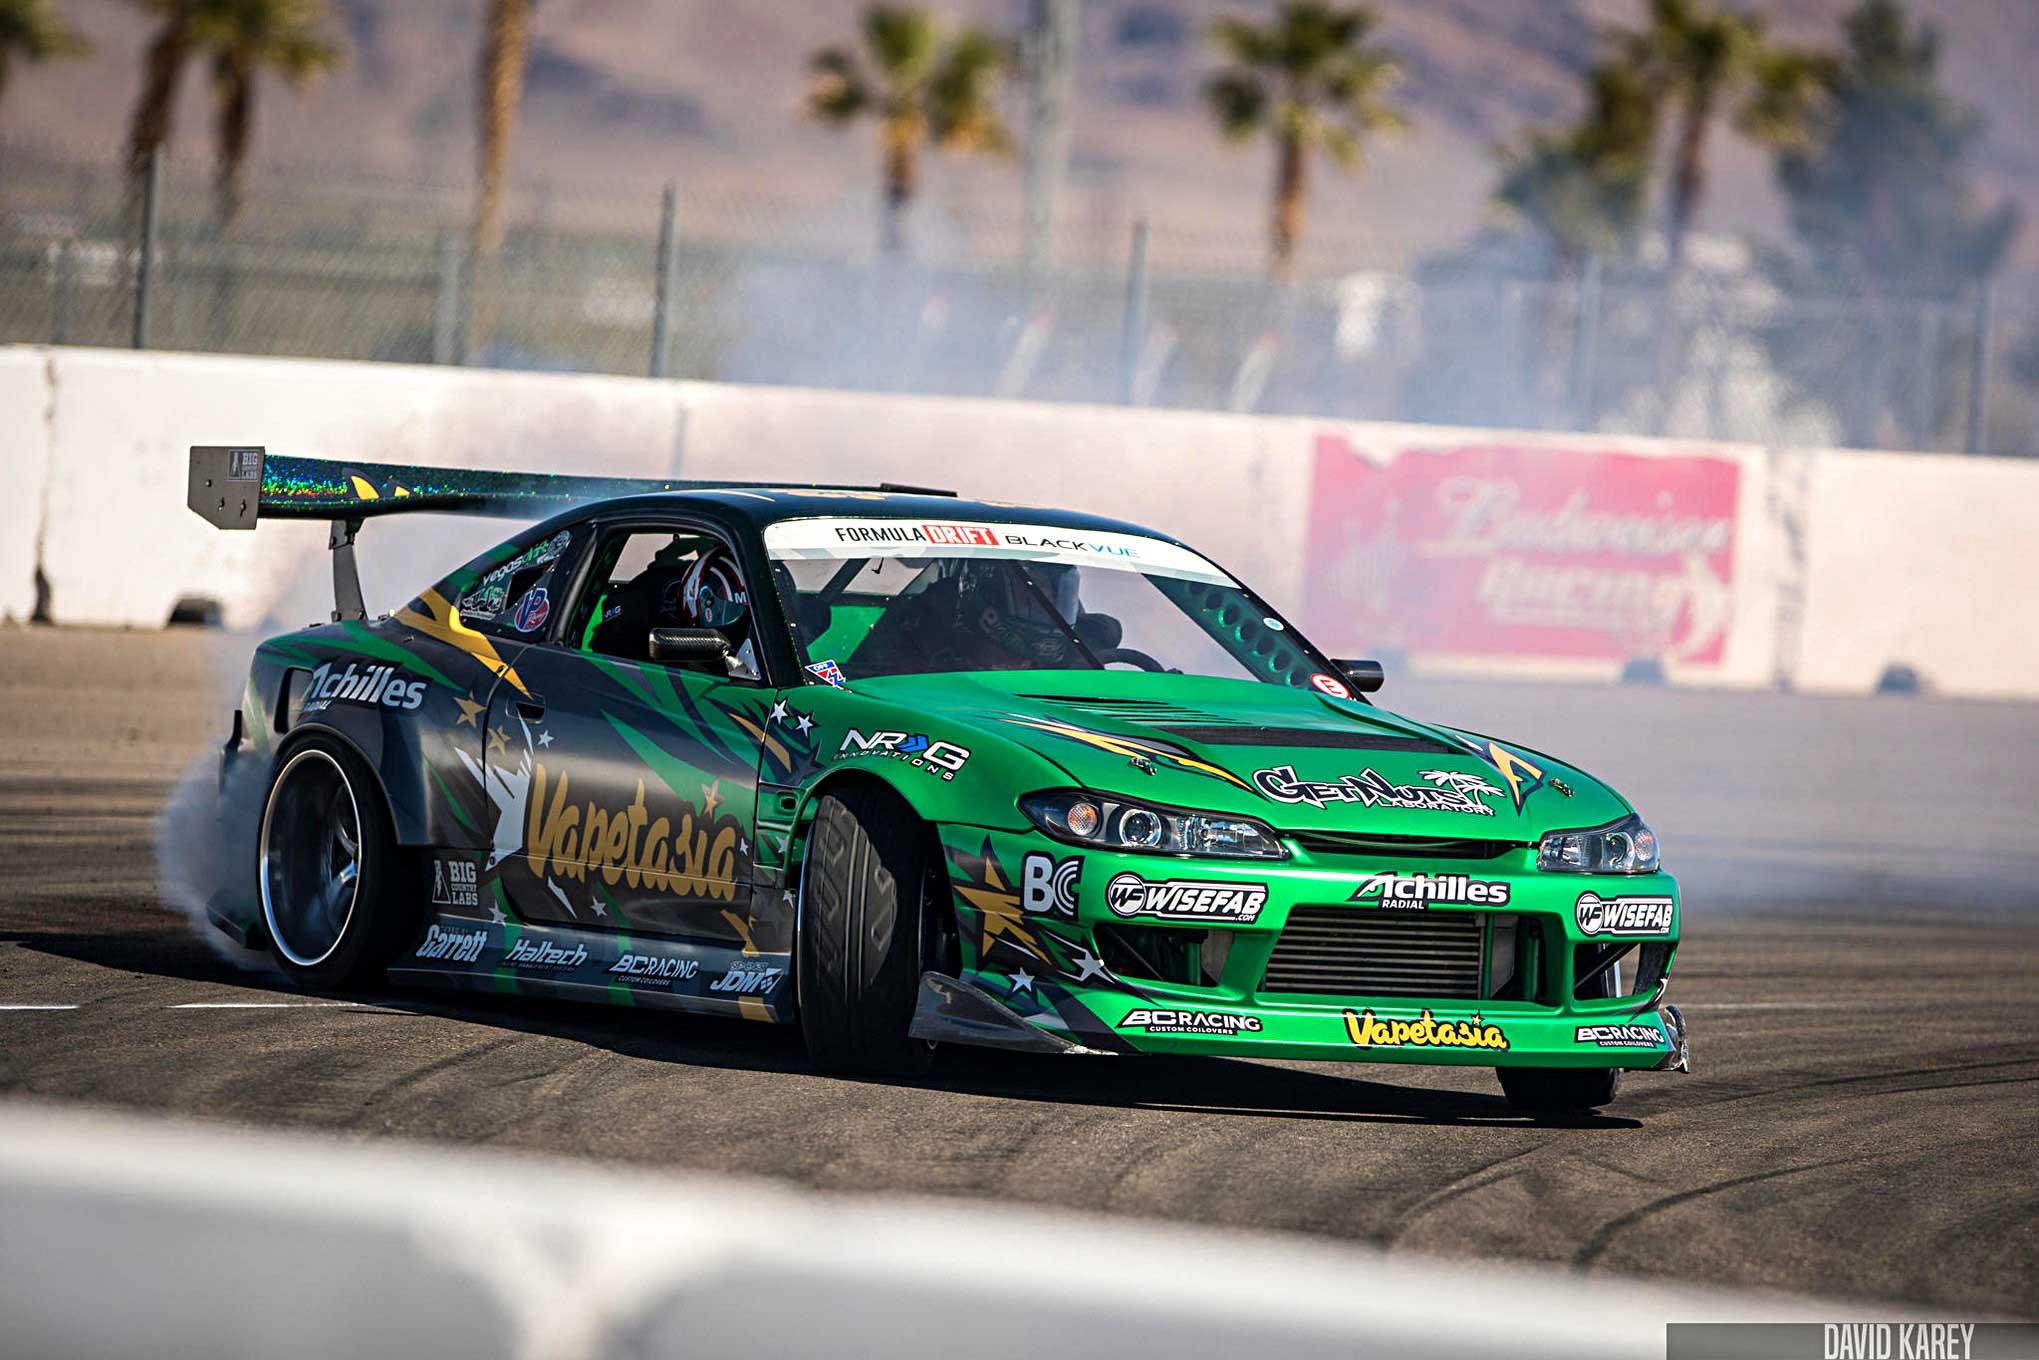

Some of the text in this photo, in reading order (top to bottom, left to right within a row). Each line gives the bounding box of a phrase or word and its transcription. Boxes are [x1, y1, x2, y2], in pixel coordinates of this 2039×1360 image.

[242, 452, 258, 465] BIG
[836, 525, 994, 545] FORMULA DRIFT
[1005, 535, 1140, 558] BLACKVUE
[311, 662, 427, 709] Achilles
[832, 749, 954, 780] INNOVATIONS
[1378, 799, 1496, 816] LABORATORY
[528, 763, 735, 901] Vapetasia
[448, 860, 477, 883] BIG
[452, 892, 479, 906] LABS
[1145, 886, 1265, 914] WISEFAB
[1357, 874, 1508, 903] Achilles
[1382, 900, 1425, 910] RADIAL
[1603, 904, 1674, 928] WISEFAB
[415, 924, 488, 962] Garrett
[505, 939, 588, 966] Haltech
[710, 970, 766, 993] JDM
[1186, 1026, 1234, 1035] COILOVERS
[1344, 1009, 1509, 1049] Vapetasia
